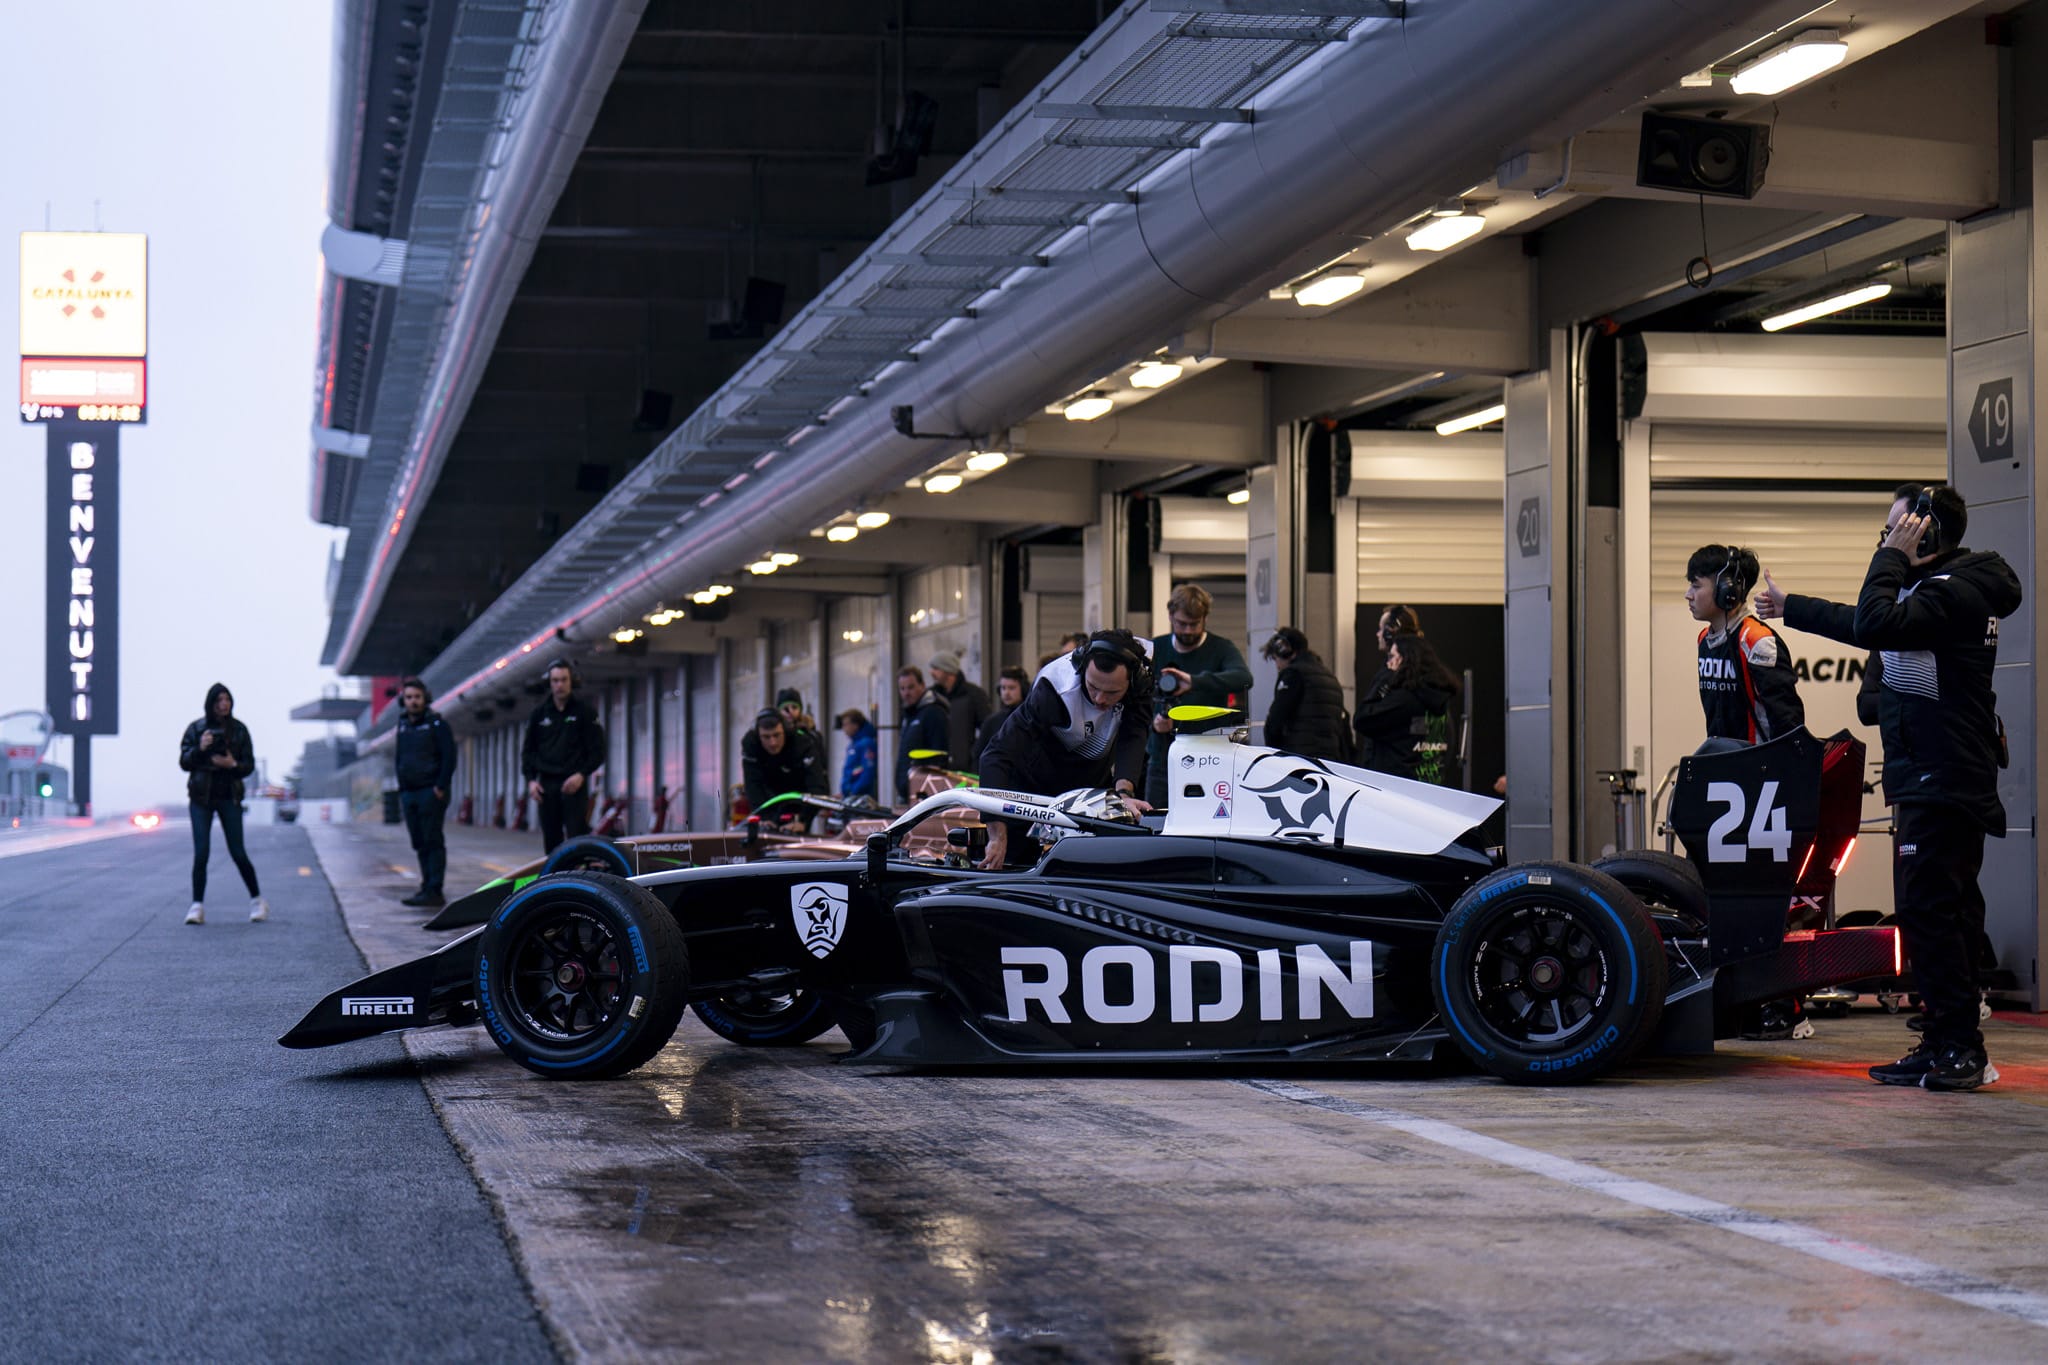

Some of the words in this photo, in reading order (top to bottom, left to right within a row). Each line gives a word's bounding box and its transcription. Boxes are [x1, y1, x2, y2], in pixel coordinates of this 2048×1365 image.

[33, 287, 134, 300] CATALUNYA
[1980, 392, 2009, 448] 19
[1521, 507, 1538, 547] 20
[69, 442, 95, 720] BENVENUTI
[1792, 658, 1868, 682] ACIN
[1199, 755, 1220, 768] ptc
[1218, 784, 1227, 795] E
[1015, 806, 1056, 821] SHARP
[1706, 780, 1793, 863] 24
[480, 957, 513, 1045] Cinturato
[1000, 940, 1374, 1024] RODIN
[342, 997, 414, 1015] PIRELLI
[1528, 1024, 1619, 1072] Cinturato
